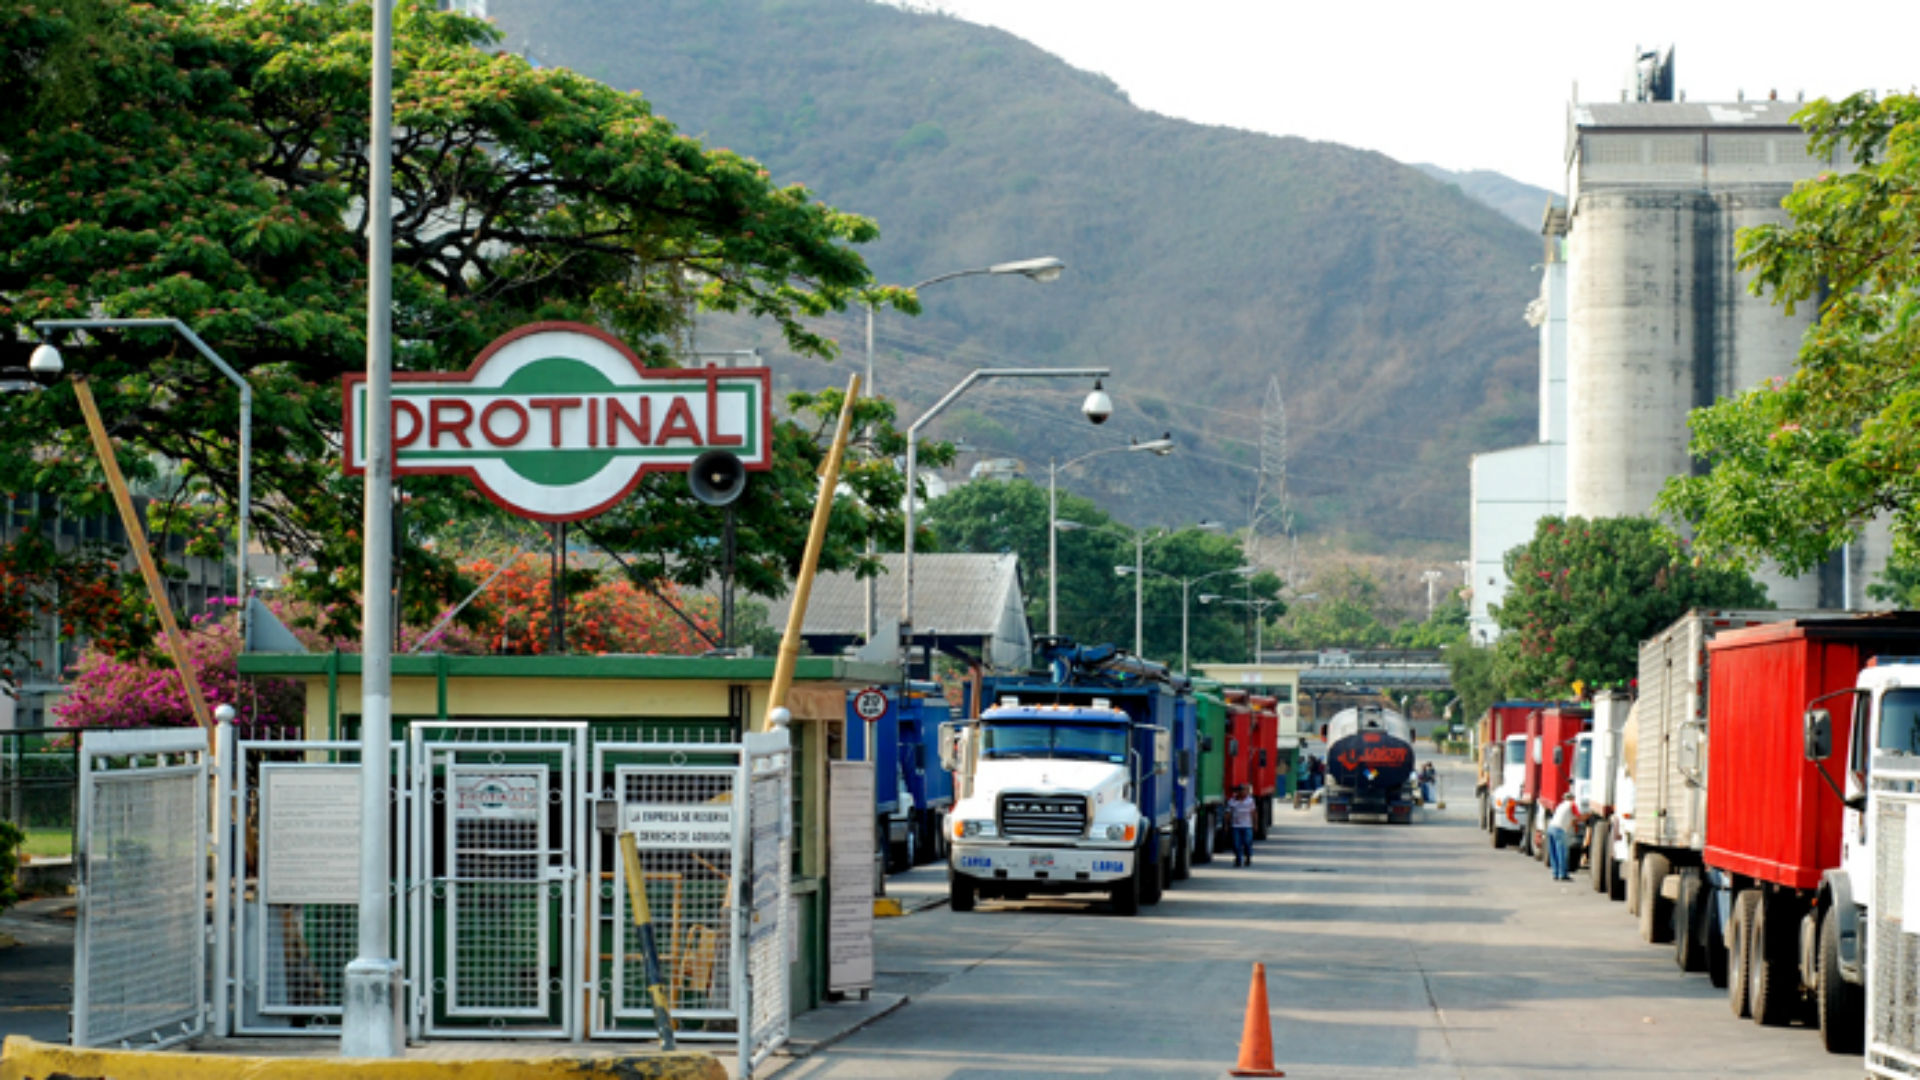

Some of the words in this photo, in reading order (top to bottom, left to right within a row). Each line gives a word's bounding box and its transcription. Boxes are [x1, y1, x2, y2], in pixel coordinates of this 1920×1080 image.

[391, 363, 742, 476] PROTINAL
[862, 694, 881, 707] 20
[643, 811, 679, 822] EMPRESA
[681, 811, 690, 822] SE
[693, 811, 729, 822] RESERVA
[639, 832, 676, 843] DERECHO
[678, 832, 690, 843] DE
